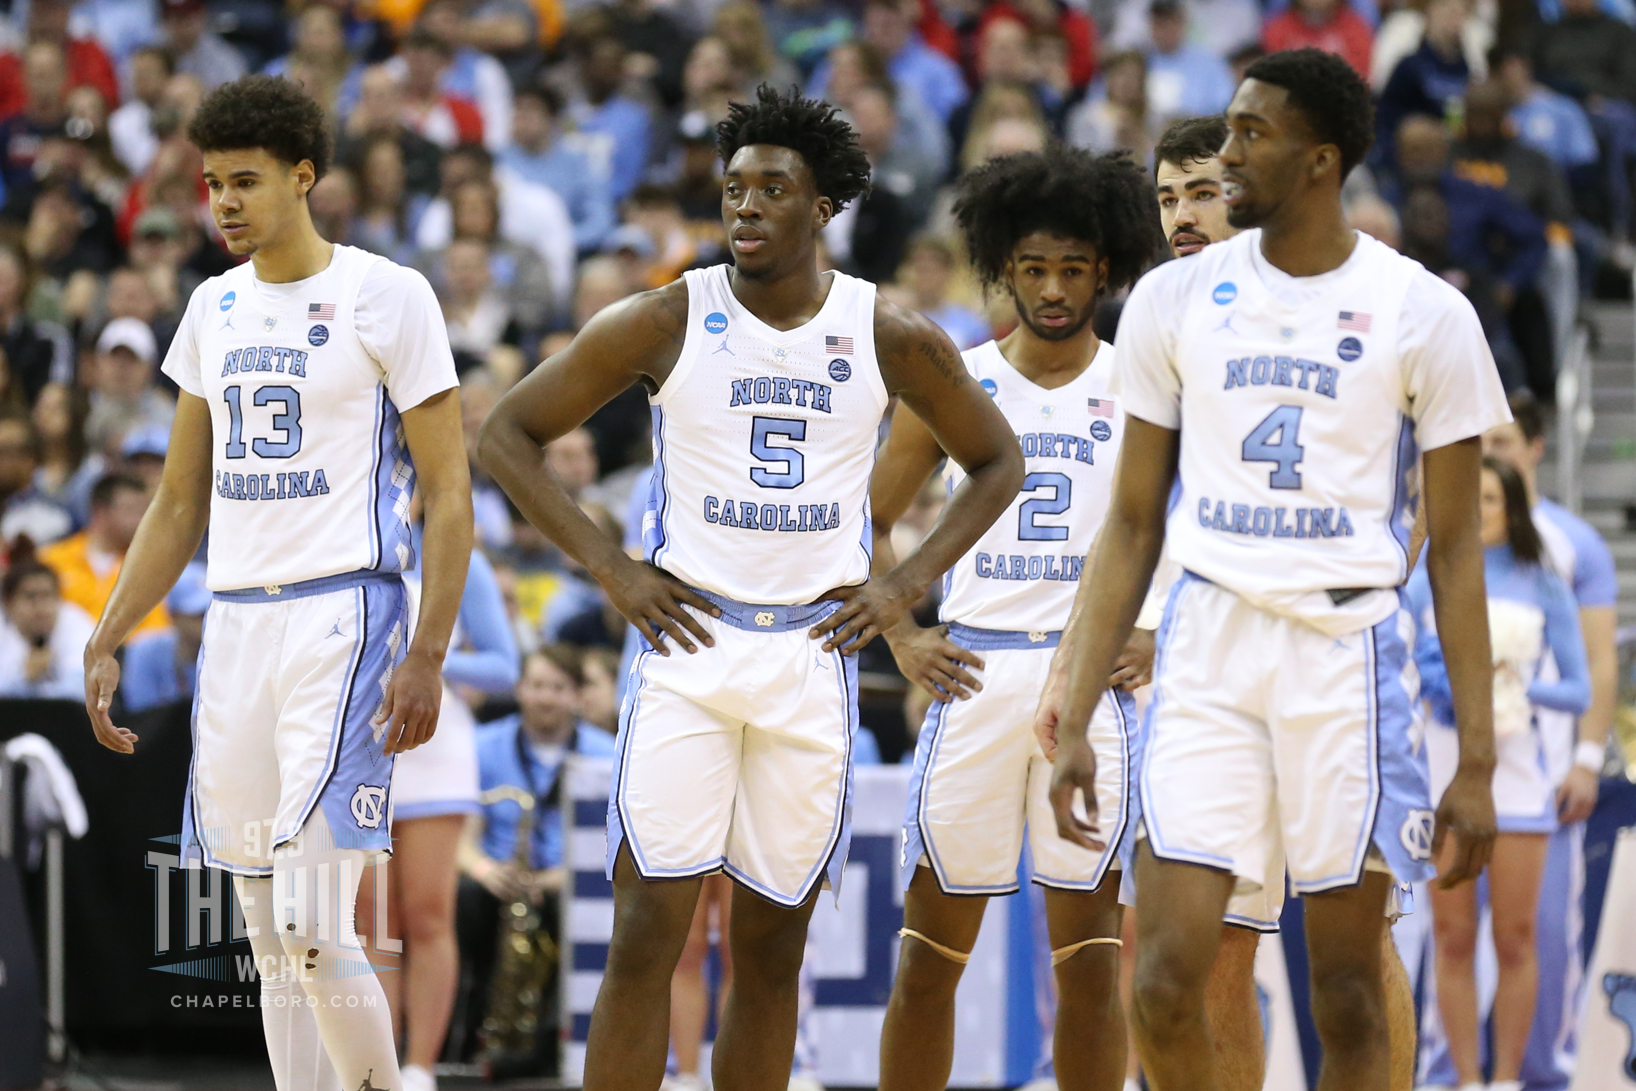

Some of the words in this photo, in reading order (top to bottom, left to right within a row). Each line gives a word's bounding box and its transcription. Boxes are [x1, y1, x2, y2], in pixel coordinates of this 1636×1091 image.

[706, 320, 726, 329] NCAA
[221, 346, 308, 378] NORTH
[832, 365, 850, 373] ACC
[1224, 355, 1340, 399] NORTH
[730, 377, 832, 413] NORTH
[223, 385, 303, 459] 13
[750, 415, 807, 489] 5
[1016, 432, 1095, 466] ORTH
[1241, 404, 1304, 490] 4
[216, 469, 330, 501] CAROLINA
[703, 495, 840, 532] CAROLINA
[1018, 472, 1072, 541] 2
[1198, 496, 1355, 538] CAROLINA
[976, 552, 1087, 581] CAROLIN
